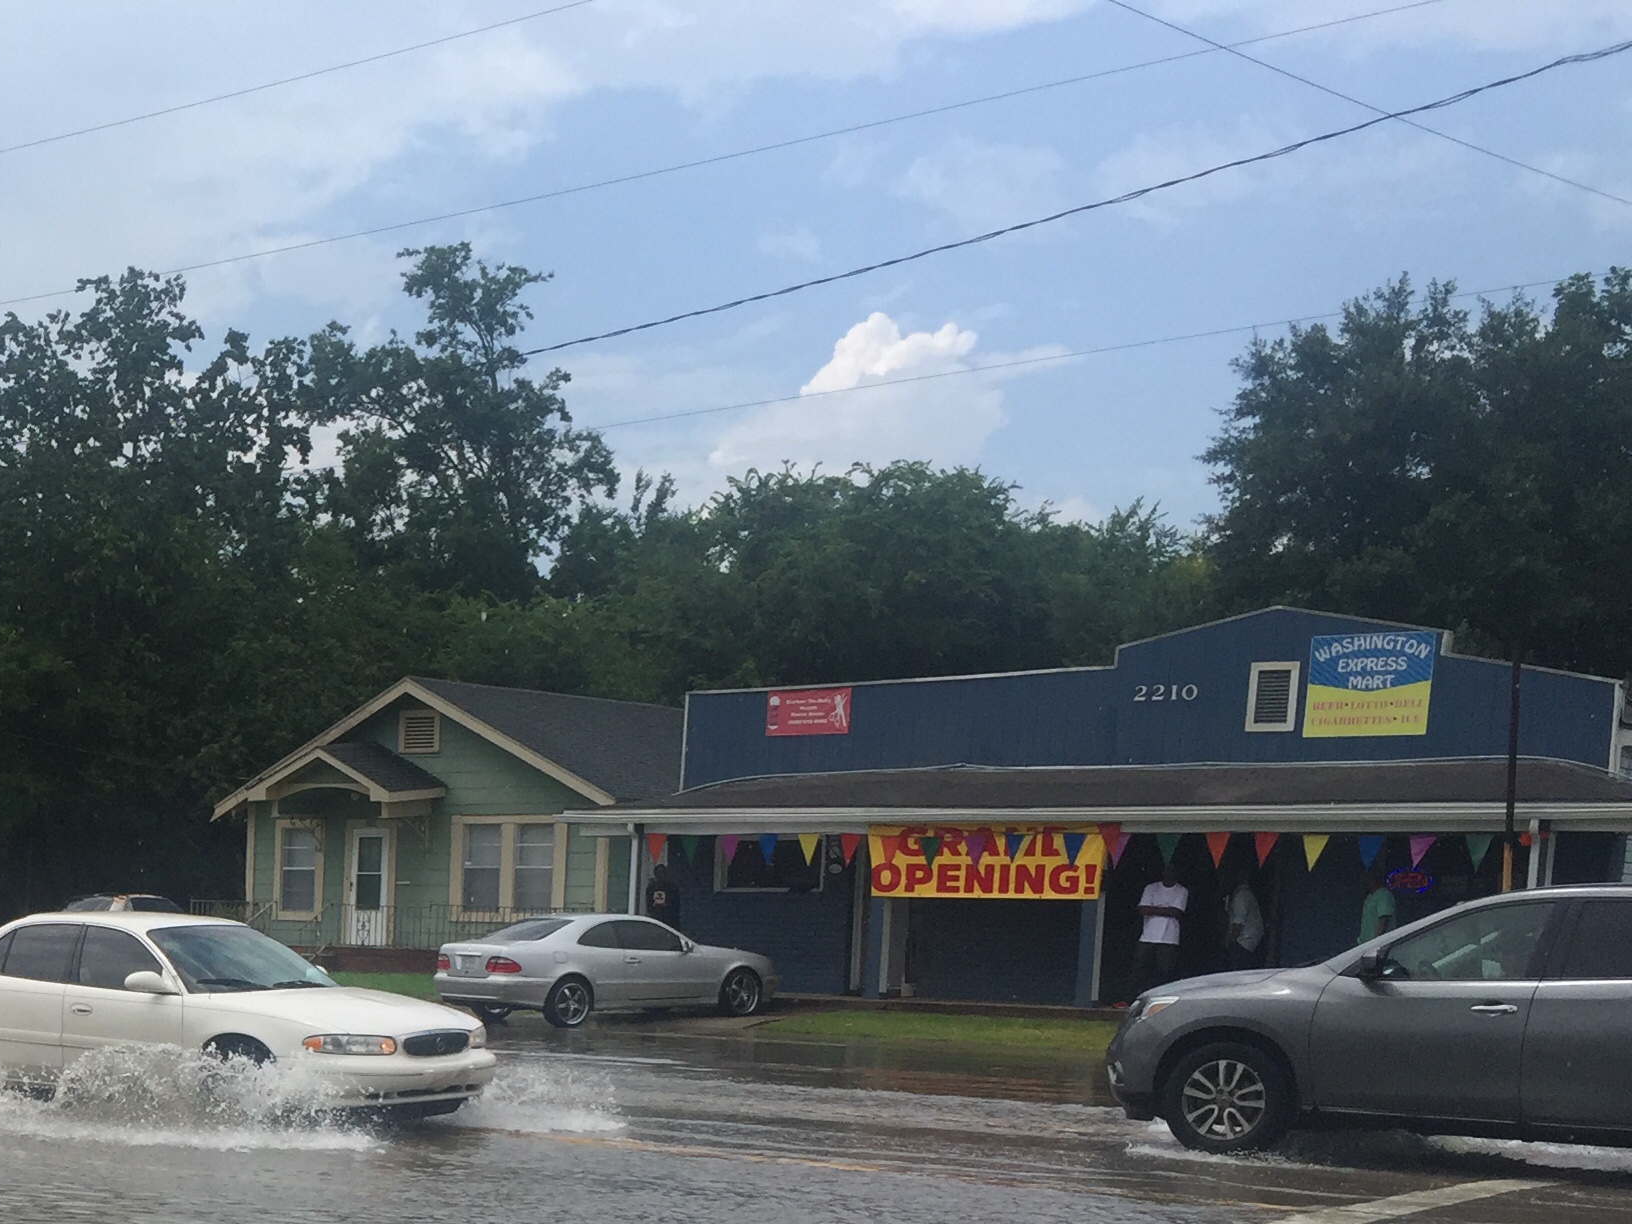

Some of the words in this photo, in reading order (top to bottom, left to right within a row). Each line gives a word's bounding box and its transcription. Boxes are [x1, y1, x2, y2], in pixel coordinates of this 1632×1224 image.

[1314, 635, 1431, 662] WASHINGTON
[1337, 656, 1408, 673] EXPRESS
[1348, 674, 1395, 690] MART
[1133, 684, 1199, 702] 2210
[1312, 701, 1344, 711] BEER
[1350, 699, 1388, 710] LOTTO
[1394, 698, 1423, 708] DELI
[870, 862, 1098, 895] OPENING!
